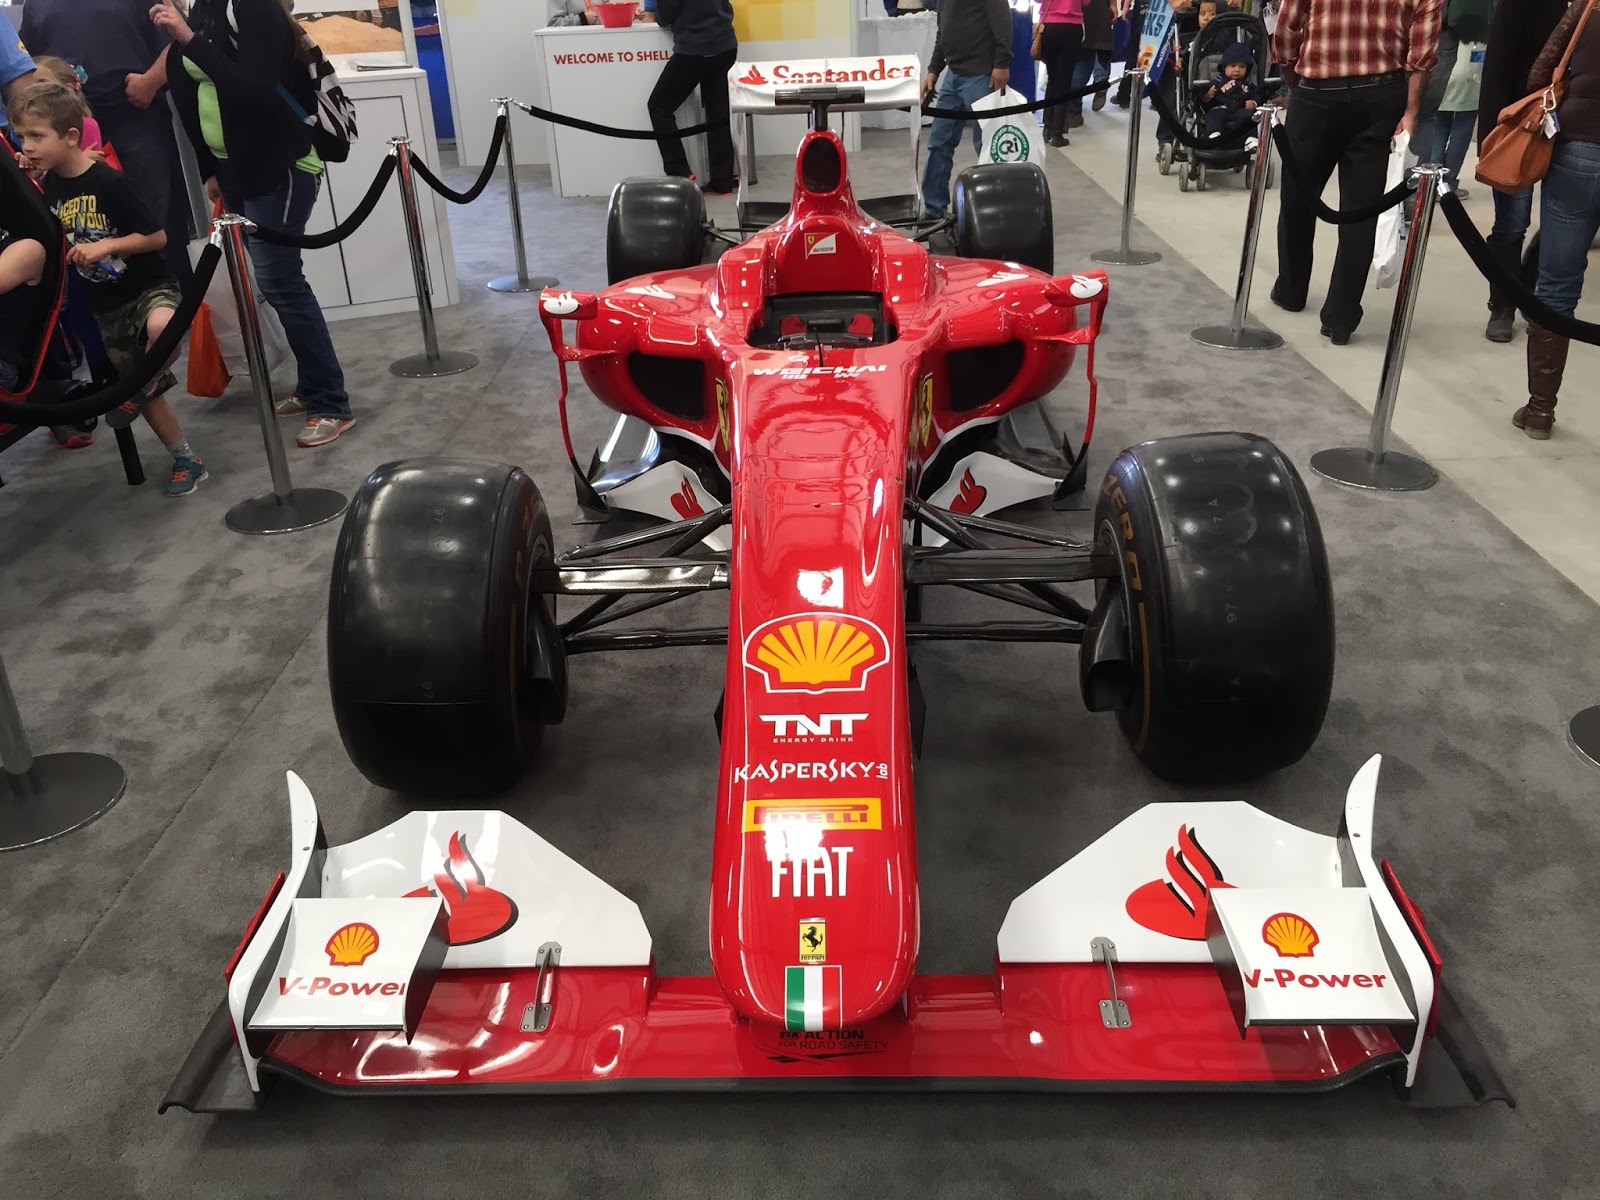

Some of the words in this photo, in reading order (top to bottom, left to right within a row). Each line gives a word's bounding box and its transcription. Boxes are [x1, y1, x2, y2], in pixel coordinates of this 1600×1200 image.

[553, 52, 614, 65] WELCOME
[617, 51, 634, 62] TO
[637, 50, 671, 61] SHELL
[772, 58, 915, 84] Santander
[81, 195, 97, 213] TO
[759, 713, 870, 736] TNT
[734, 758, 876, 784] KASPERSKY
[876, 762, 889, 780] lab
[770, 846, 854, 897] FIAT
[1243, 968, 1387, 988] V-Power
[778, 1040, 797, 1048] FOR
[799, 1040, 836, 1050] ROAD
[838, 1040, 889, 1050] SAFETY
[804, 1030, 864, 1040] ACTION
